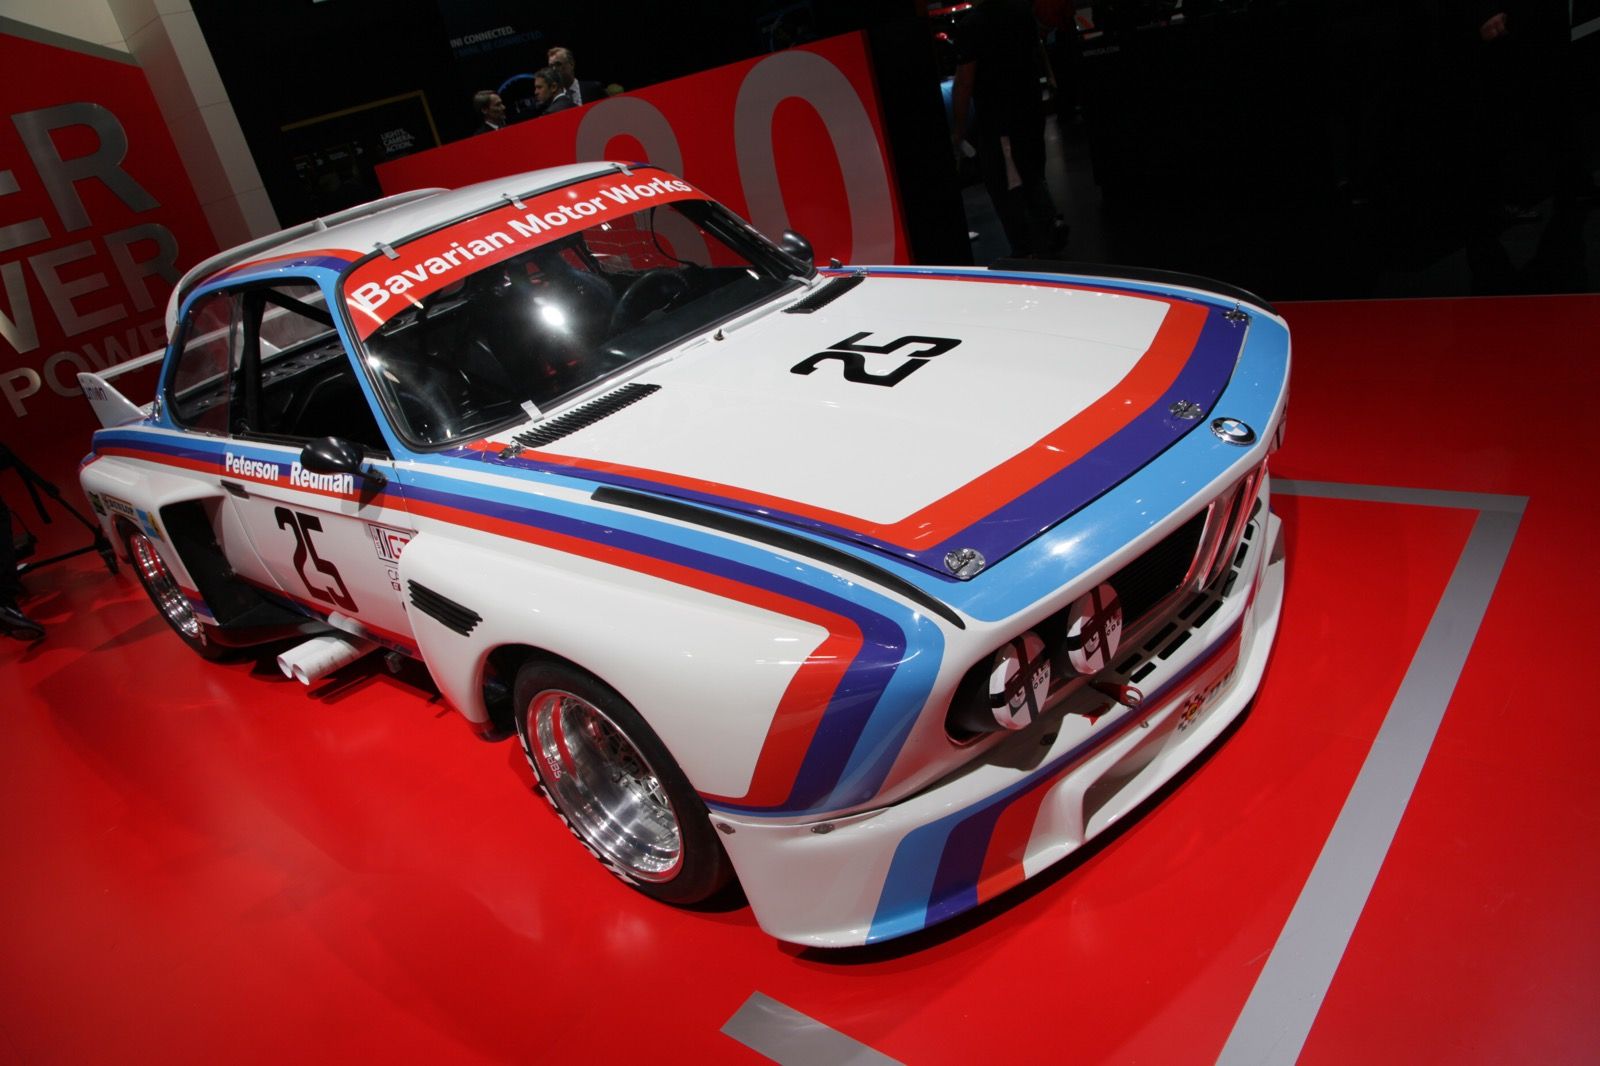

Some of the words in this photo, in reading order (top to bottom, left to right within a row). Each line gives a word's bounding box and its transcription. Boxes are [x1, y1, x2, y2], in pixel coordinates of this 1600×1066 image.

[351, 228, 515, 312] Bavarian
[507, 195, 602, 238] Motor
[599, 176, 693, 205] Works
[790, 331, 962, 388] 25
[225, 451, 279, 481] Peterson
[289, 461, 354, 495] Redman
[274, 506, 359, 613] 25
